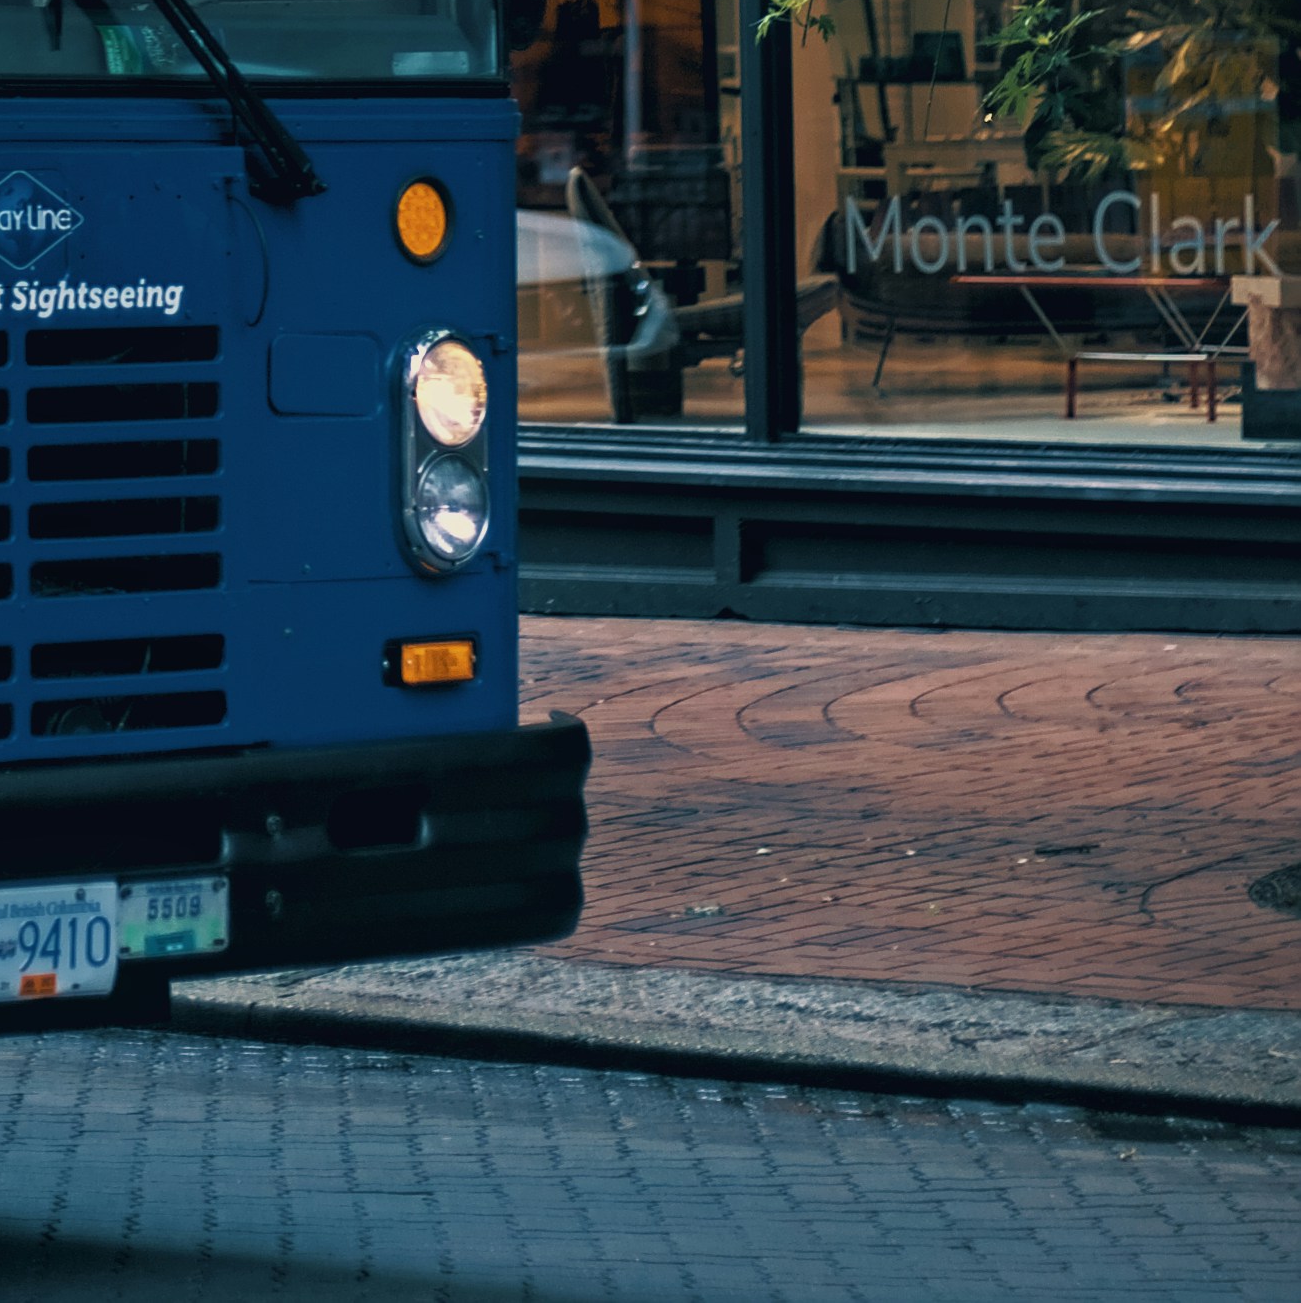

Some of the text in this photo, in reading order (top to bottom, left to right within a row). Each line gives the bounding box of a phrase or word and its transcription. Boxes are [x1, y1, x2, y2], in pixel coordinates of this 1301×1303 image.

[844, 190, 1284, 277] Monte Clark
[11, 279, 184, 319] Sightseeing
[147, 896, 201, 920] 5509
[18, 915, 112, 972] 9410
